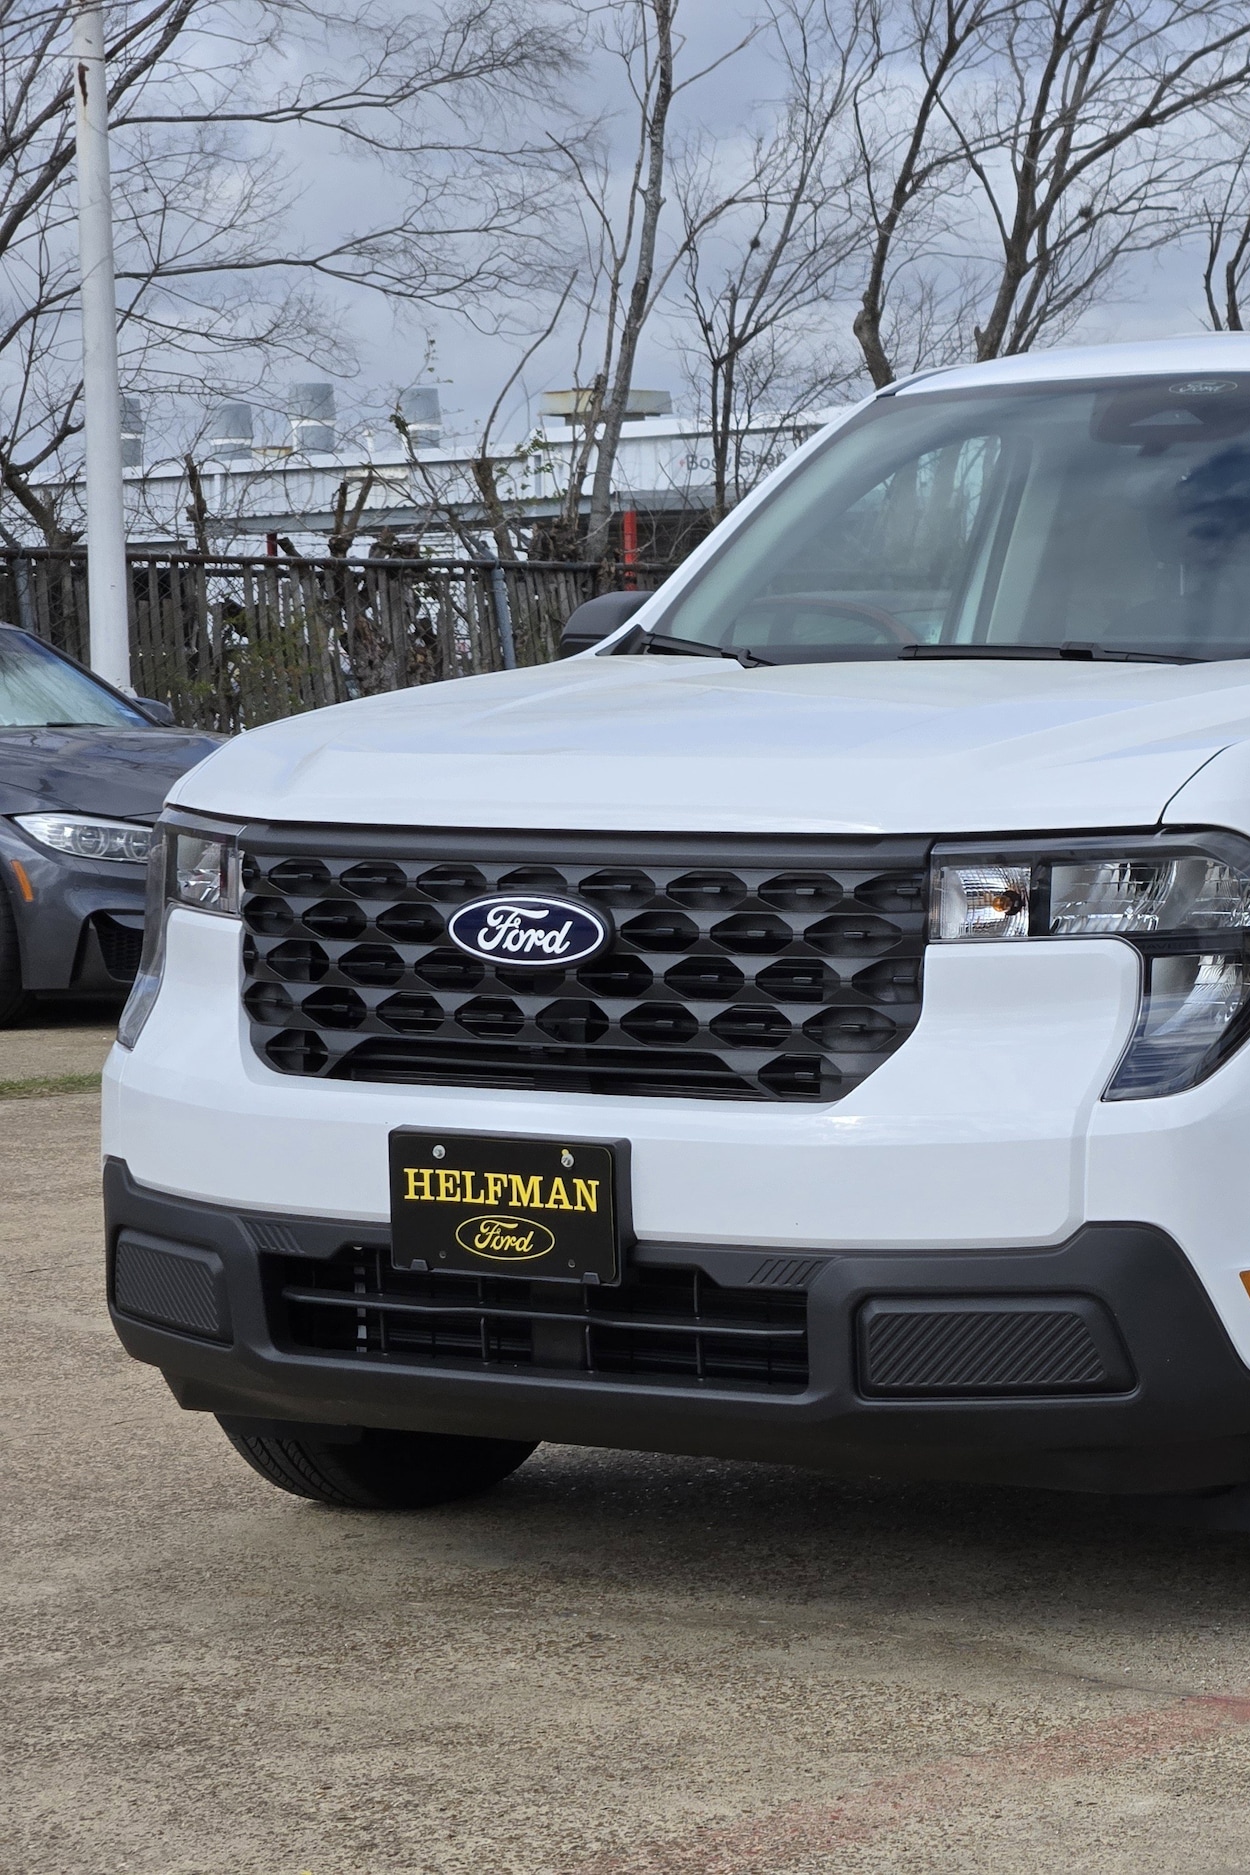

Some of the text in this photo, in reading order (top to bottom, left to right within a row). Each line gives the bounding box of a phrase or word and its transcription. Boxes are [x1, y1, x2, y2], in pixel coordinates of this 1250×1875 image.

[1179, 381, 1226, 393] Ford
[477, 905, 573, 954] Ford
[403, 1168, 600, 1212] HELFMAN
[474, 1219, 535, 1253] Ford
